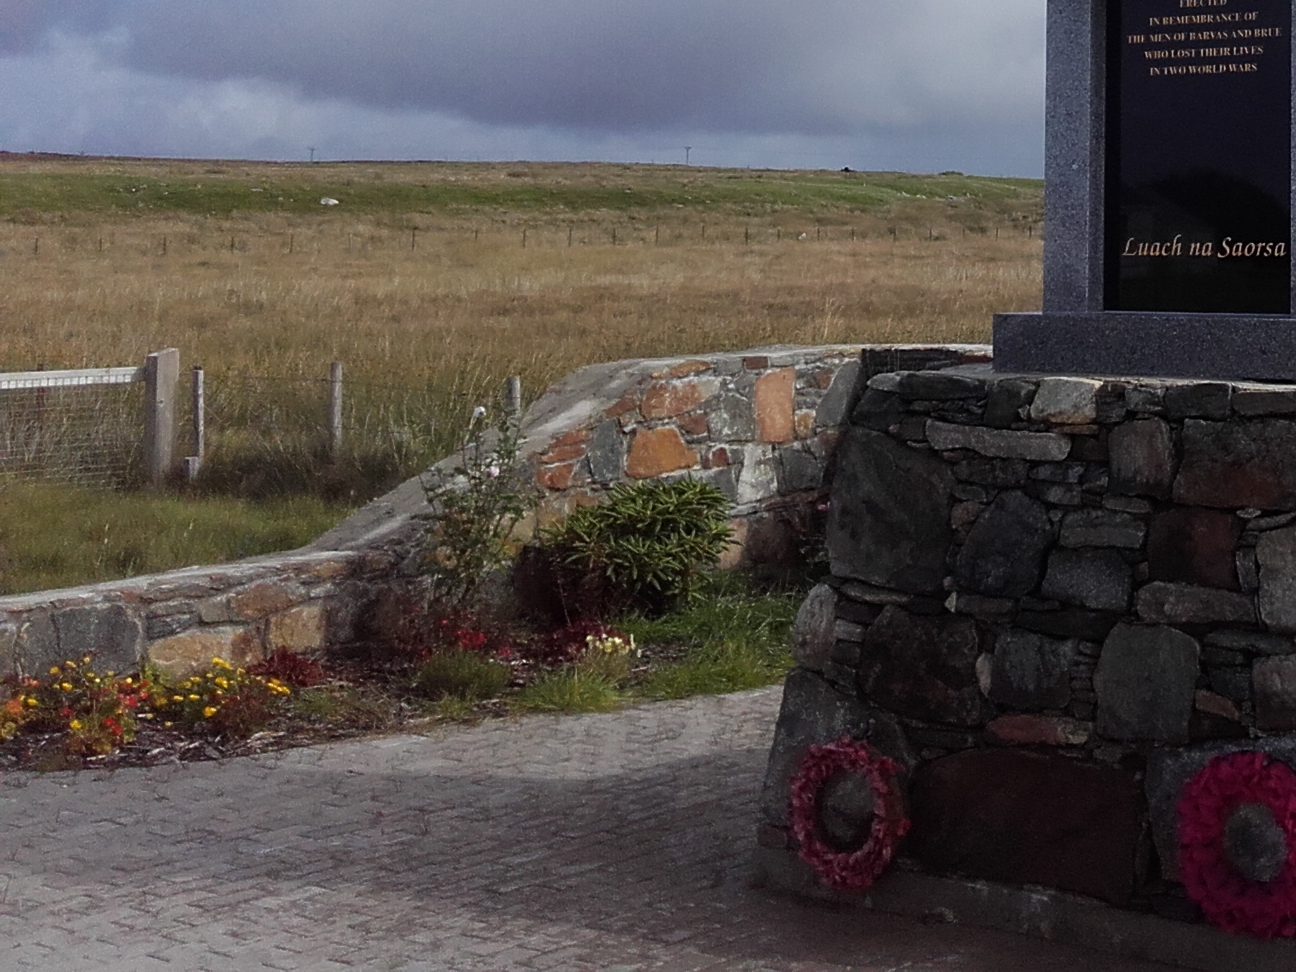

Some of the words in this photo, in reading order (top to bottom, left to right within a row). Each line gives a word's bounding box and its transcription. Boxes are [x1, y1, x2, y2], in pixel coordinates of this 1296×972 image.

[1149, 17, 1160, 26] IN
[1162, 13, 1242, 26] REMEMBRANCE
[1244, 11, 1259, 21] OF
[1126, 35, 1147, 44] THE
[1149, 33, 1172, 43] MEN
[1173, 33, 1187, 42] OF
[1189, 31, 1228, 41] BARVAS
[1232, 29, 1252, 39] AND
[1253, 27, 1283, 38] BRUE
[1144, 50, 1169, 60] WHO
[1171, 49, 1196, 58] LOST
[1200, 47, 1230, 57] THEIR
[1233, 45, 1264, 56] LIVES
[1150, 66, 1161, 76] IN
[1162, 65, 1187, 75] TWO
[1189, 64, 1227, 74] WORLD
[1228, 63, 1258, 73] WARS
[1122, 234, 1182, 257] Luach
[1189, 242, 1213, 257] na
[1217, 236, 1287, 258] Saorsa
